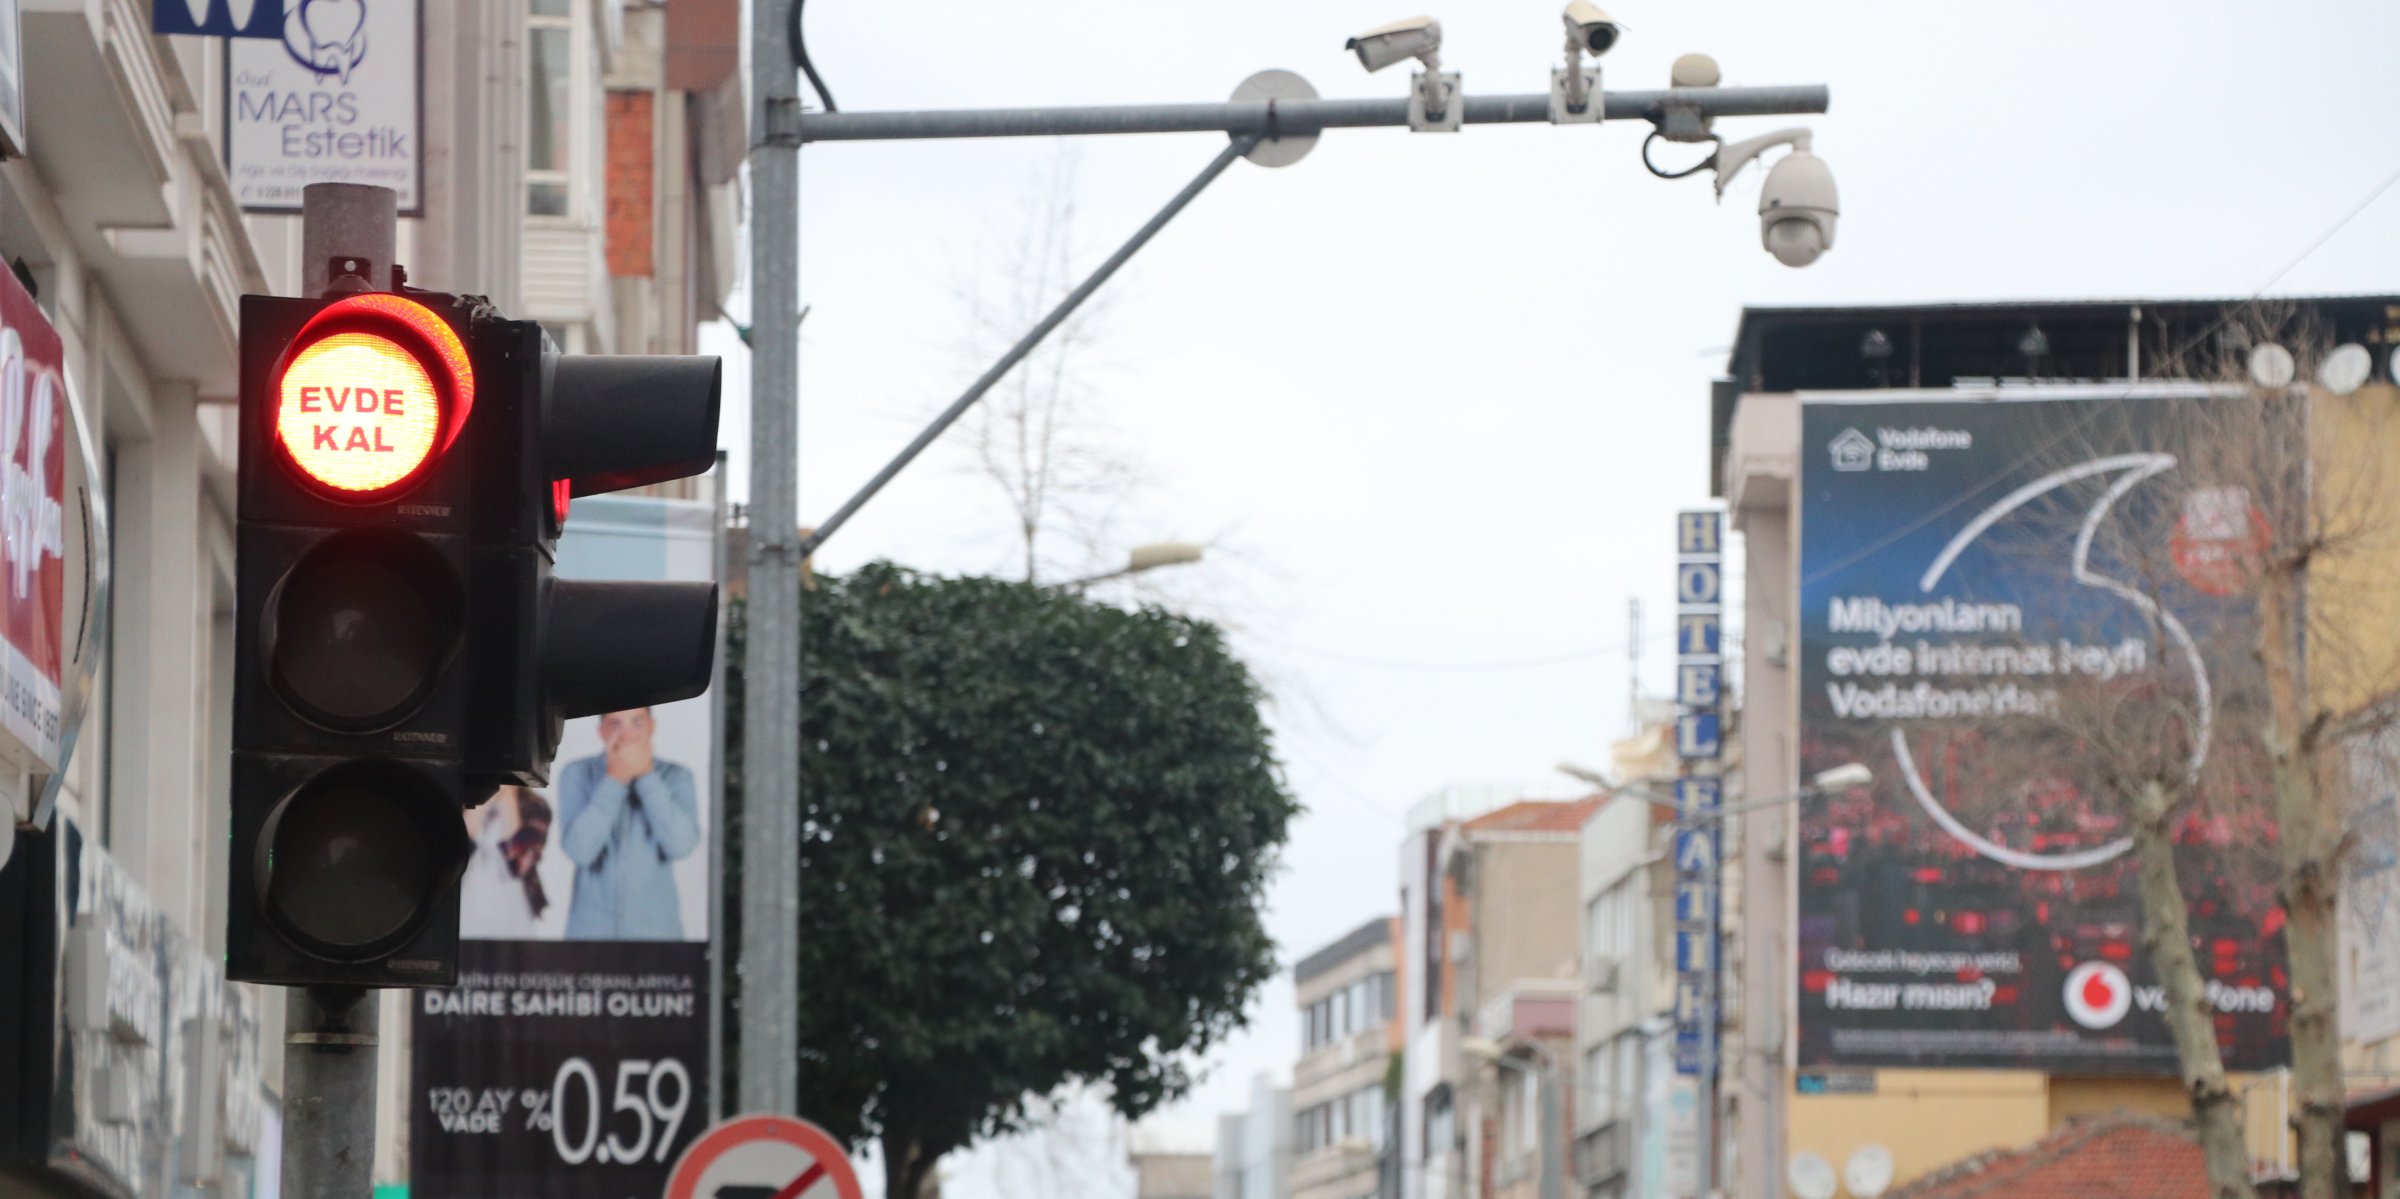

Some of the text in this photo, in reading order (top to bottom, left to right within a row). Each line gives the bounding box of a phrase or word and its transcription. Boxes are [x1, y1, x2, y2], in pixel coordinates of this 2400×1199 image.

[238, 90, 357, 125] MARS
[281, 125, 408, 159] Estetik
[300, 386, 404, 416] EVDE
[313, 425, 395, 453] KAL
[1876, 426, 1973, 450] Vodafone
[1877, 449, 1929, 471] Evde
[1680, 513, 1719, 756] HOTEL
[1826, 641, 1912, 676] evde
[424, 987, 694, 1017] DAİRE SAHİBİ OLUN!
[1825, 977, 1996, 1010] Hazır mısın?
[2133, 979, 2275, 1013] vofone
[429, 1087, 515, 1114] 120 AY
[439, 1111, 502, 1133] VADE
